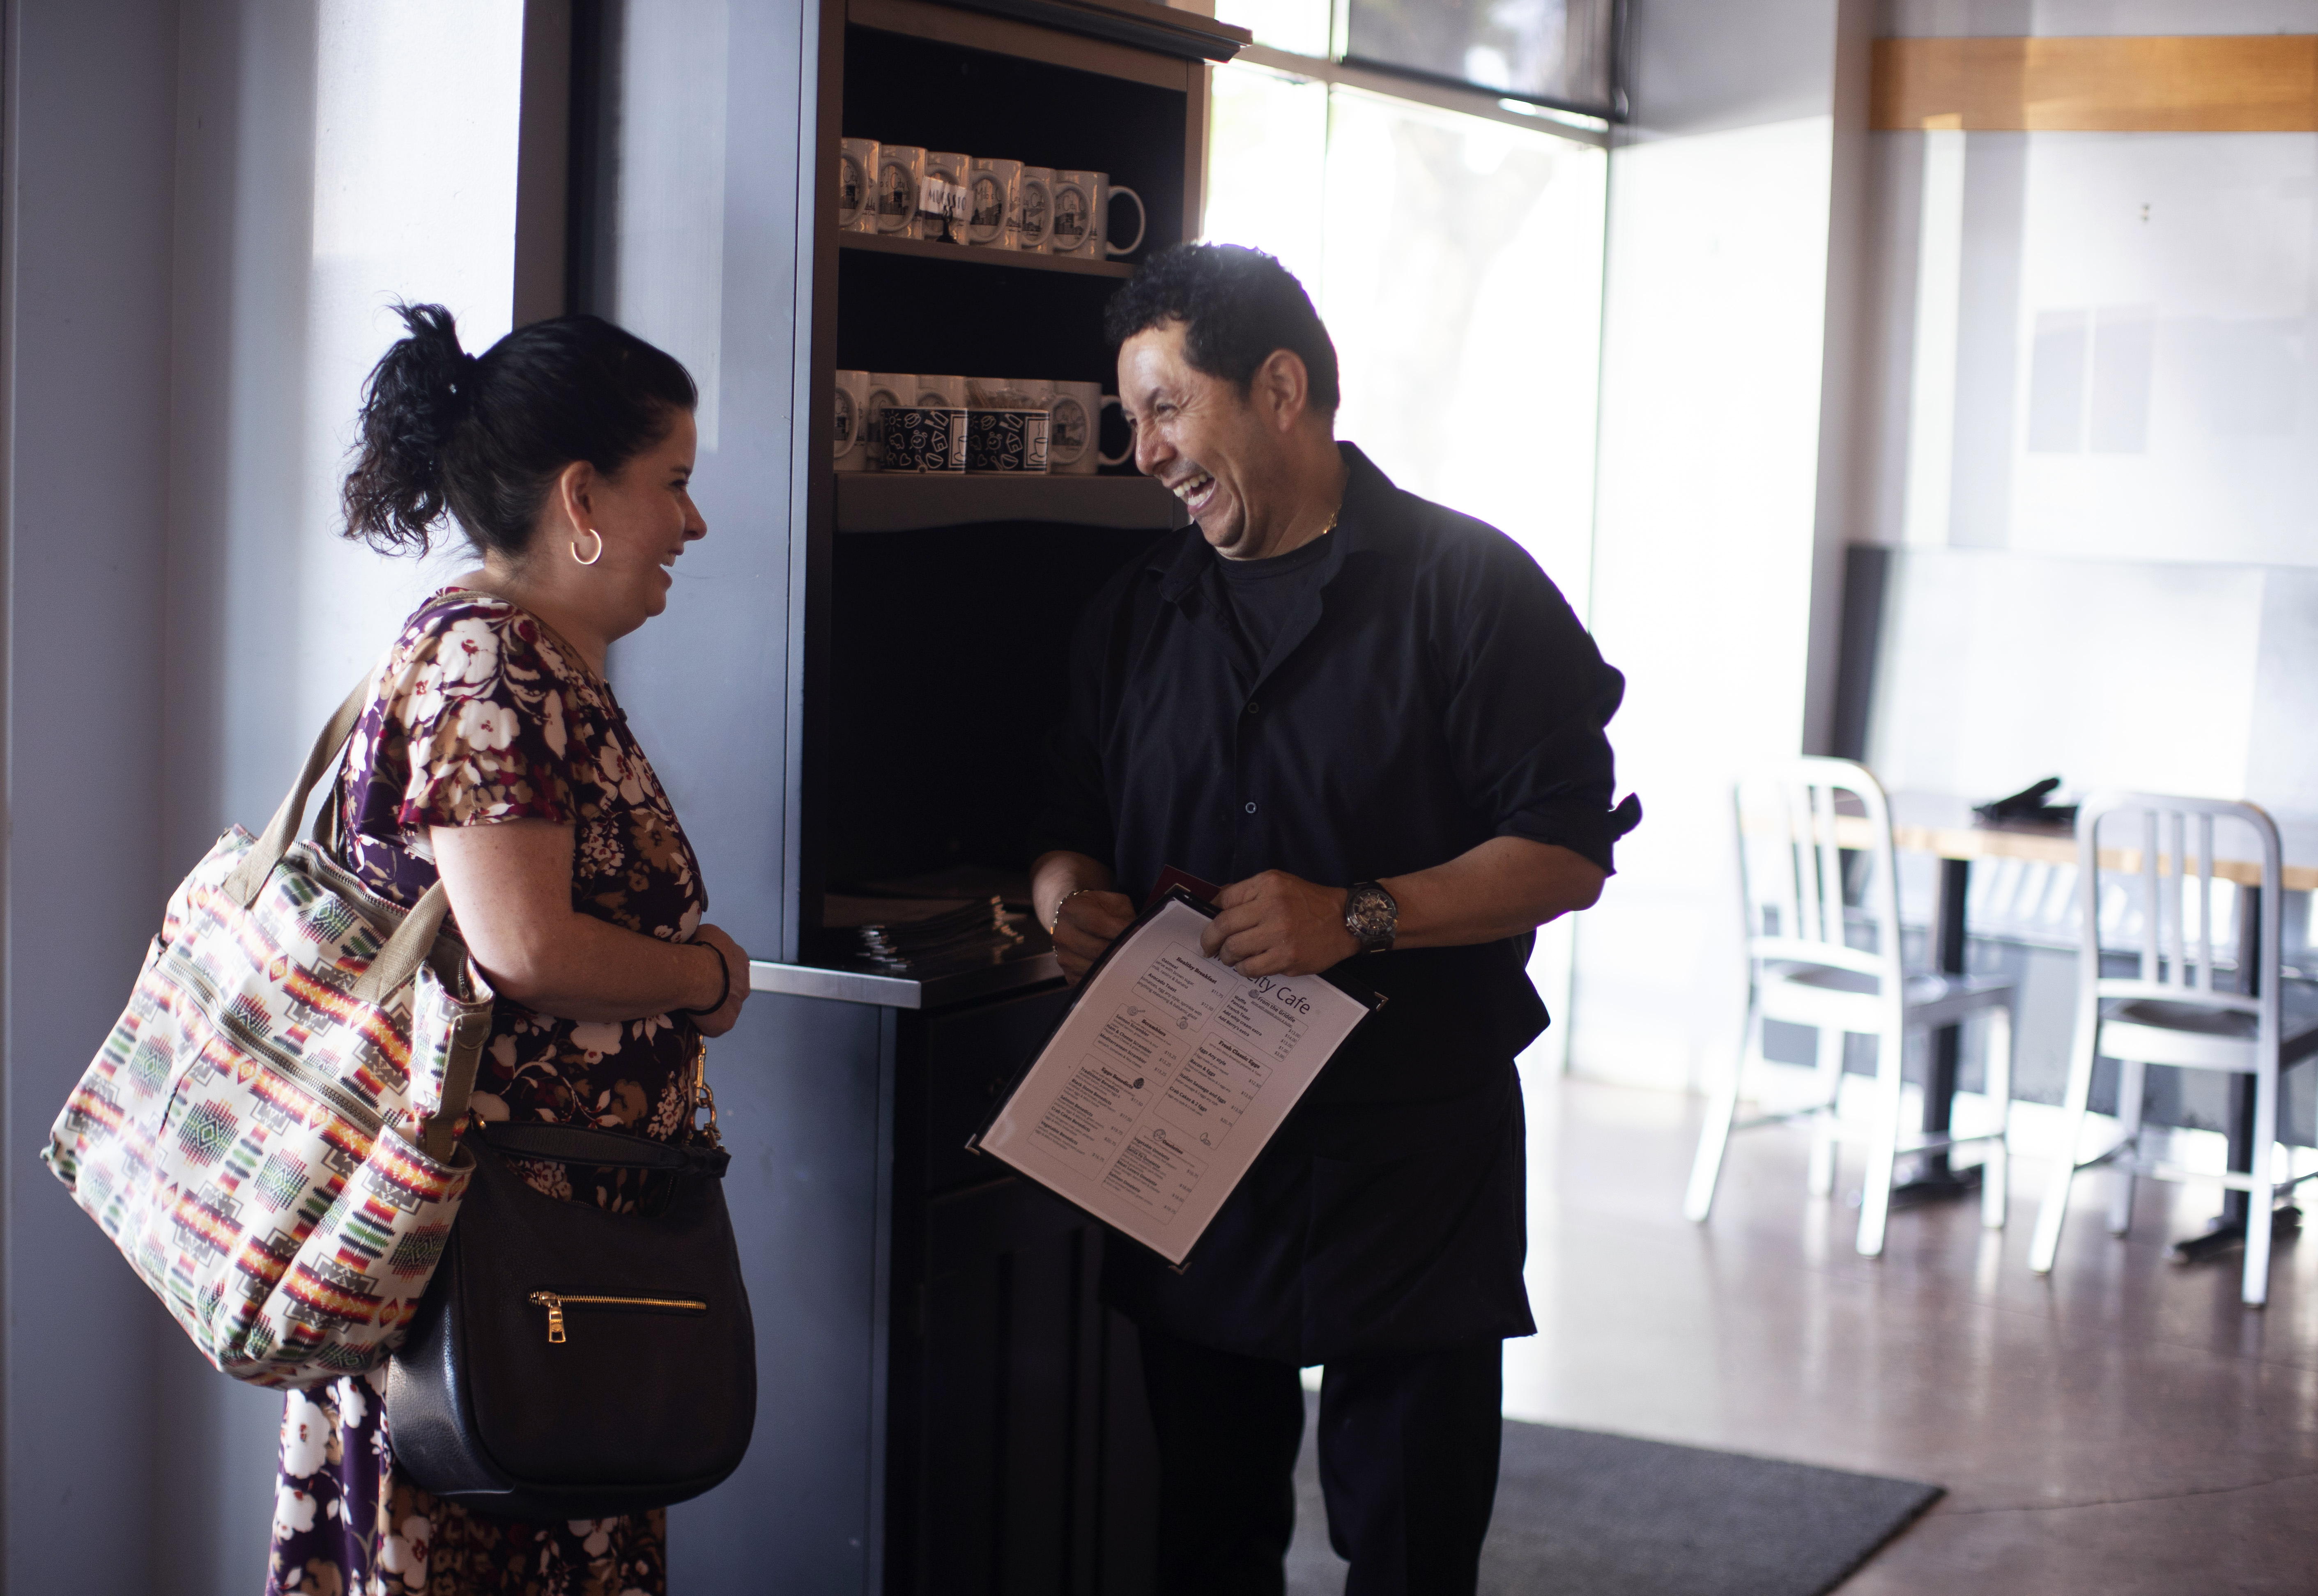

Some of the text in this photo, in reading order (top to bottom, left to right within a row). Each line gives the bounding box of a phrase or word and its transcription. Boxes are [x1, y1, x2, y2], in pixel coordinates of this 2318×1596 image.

[1161, 958, 1178, 969] Oatmeal
[1176, 957, 1195, 971] Healthy
[1194, 968, 1217, 984] Breakfast
[1148, 973, 1177, 993] Avocado Toast
[1160, 970, 1172, 979] raisins
[1175, 979, 1189, 989] banana
[1173, 971, 1184, 979] brown
[1136, 981, 1153, 993] anything
[1152, 990, 1170, 1004] seasoning
[1173, 1003, 1188, 1014] balsamic
[1140, 976, 1157, 989] tomatoes,
[1180, 1001, 1194, 1011] sprinkle
[1211, 989, 1223, 999] $11.75
[1234, 995, 1246, 1005] Waffle
[1247, 975, 1310, 1014] ity Cafe
[1201, 1002, 1214, 1011] $12.50
[1227, 1004, 1251, 1021] French Toast
[1231, 999, 1248, 1012] Pancakes
[1258, 997, 1270, 1007] From
[1279, 1010, 1295, 1023] Griddle
[1116, 1014, 1130, 1025] Salmon
[1130, 1023, 1149, 1036] Scrambler
[1141, 1019, 1166, 1036] Scramblers
[1226, 1020, 1239, 1030] Berry's
[1240, 1021, 1252, 1029] cream
[1288, 1029, 1301, 1038] $13.00
[1119, 1032, 1133, 1043] Cheese
[1133, 1040, 1152, 1054] Scrambler
[1281, 1039, 1293, 1048] $13.00
[1285, 1033, 1297, 1043] $14.00
[1099, 1033, 1128, 1052] Mediterranean
[1127, 1050, 1147, 1064] Scrambler
[1219, 1040, 1260, 1069] Fresh Classic Eggs
[1190, 1059, 1203, 1068] Bacon
[1081, 1067, 1102, 1082] Traditional
[1101, 1079, 1120, 1093] Benedicts
[1101, 1067, 1113, 1076] Eggs
[1113, 1074, 1135, 1089] Benedicts
[1180, 1073, 1193, 1083] Italian
[1193, 1081, 1209, 1093] Sausage
[1249, 1079, 1261, 1088] $12.50
[1072, 1079, 1082, 1087] Black
[1082, 1085, 1094, 1094] Stone
[1093, 1092, 1112, 1105] Benedicts
[1169, 1086, 1180, 1094] Crab
[1179, 1092, 1191, 1102] Cakes
[1060, 1095, 1075, 1105] Salmon
[1074, 1104, 1093, 1117] Benedicts
[1060, 1112, 1072, 1121] Cakes
[1072, 1119, 1090, 1132] Benedicts
[1041, 1121, 1060, 1134] Vegetable
[1060, 1132, 1078, 1145] Benedicts
[1162, 1139, 1183, 1154] Omelettes
